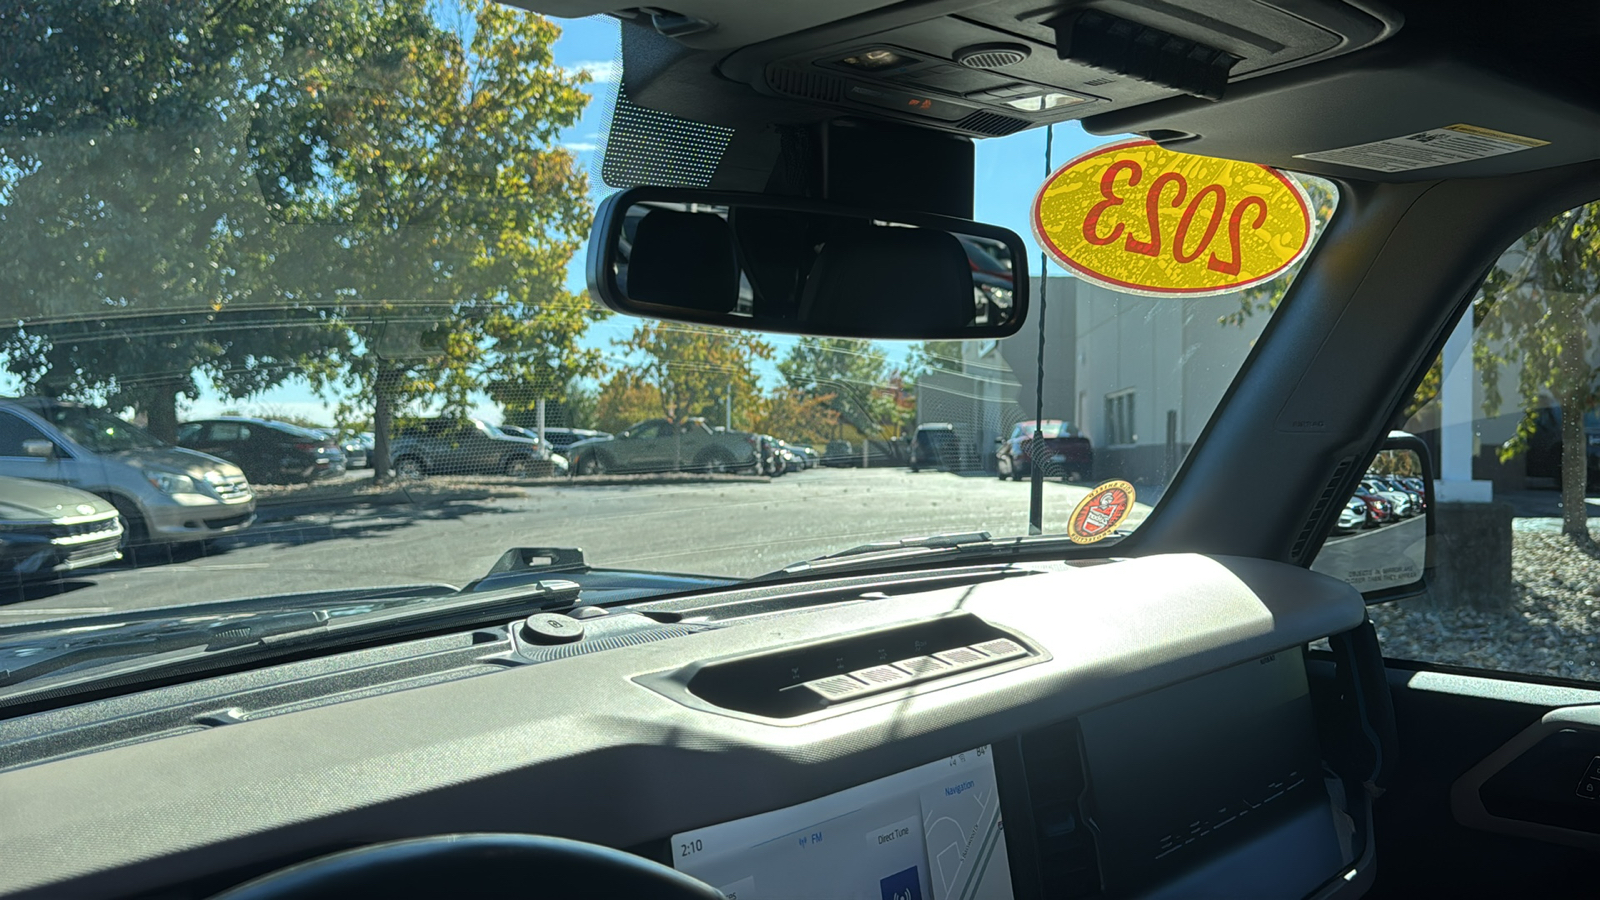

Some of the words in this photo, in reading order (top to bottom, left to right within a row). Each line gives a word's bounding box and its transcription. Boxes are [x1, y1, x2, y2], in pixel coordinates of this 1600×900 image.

[944, 780, 975, 796] Navigation
[811, 831, 823, 845] FM
[877, 832, 895, 845] Direct
[894, 826, 910, 838] Tune
[680, 839, 703, 857] 2:10
